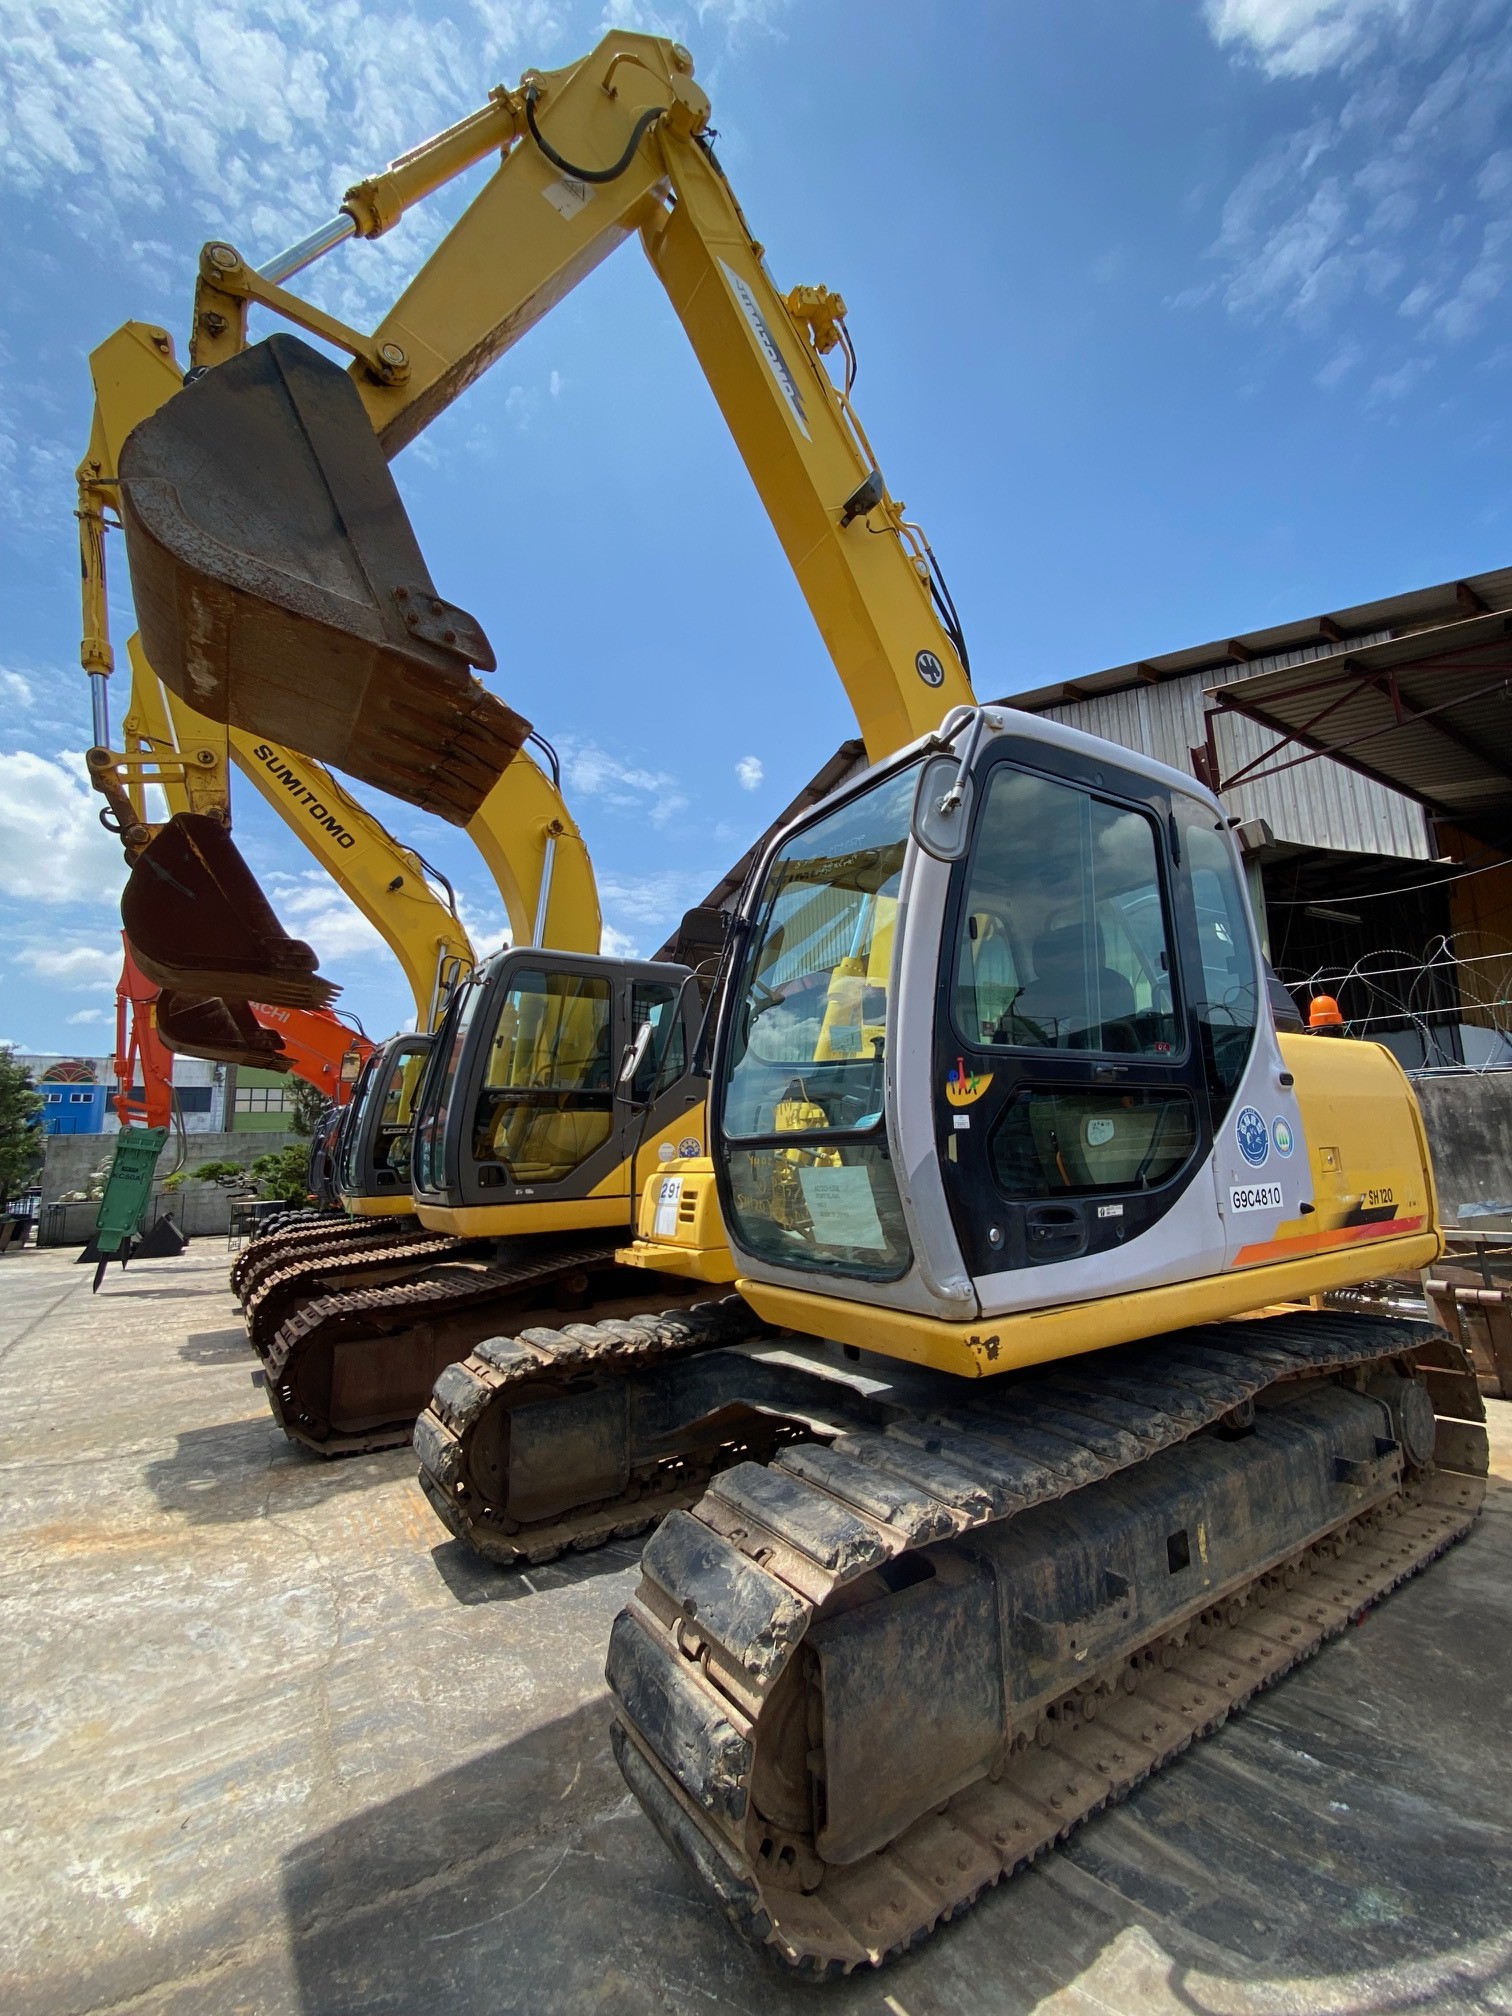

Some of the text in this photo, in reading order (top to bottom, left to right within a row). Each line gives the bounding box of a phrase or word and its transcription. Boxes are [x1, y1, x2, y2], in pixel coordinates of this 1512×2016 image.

[253, 744, 356, 849] SUMITOMO
[1232, 1187, 1281, 1209] G9C4810
[1368, 1190, 1379, 1206] SH
[1379, 1187, 1393, 1204] 120
